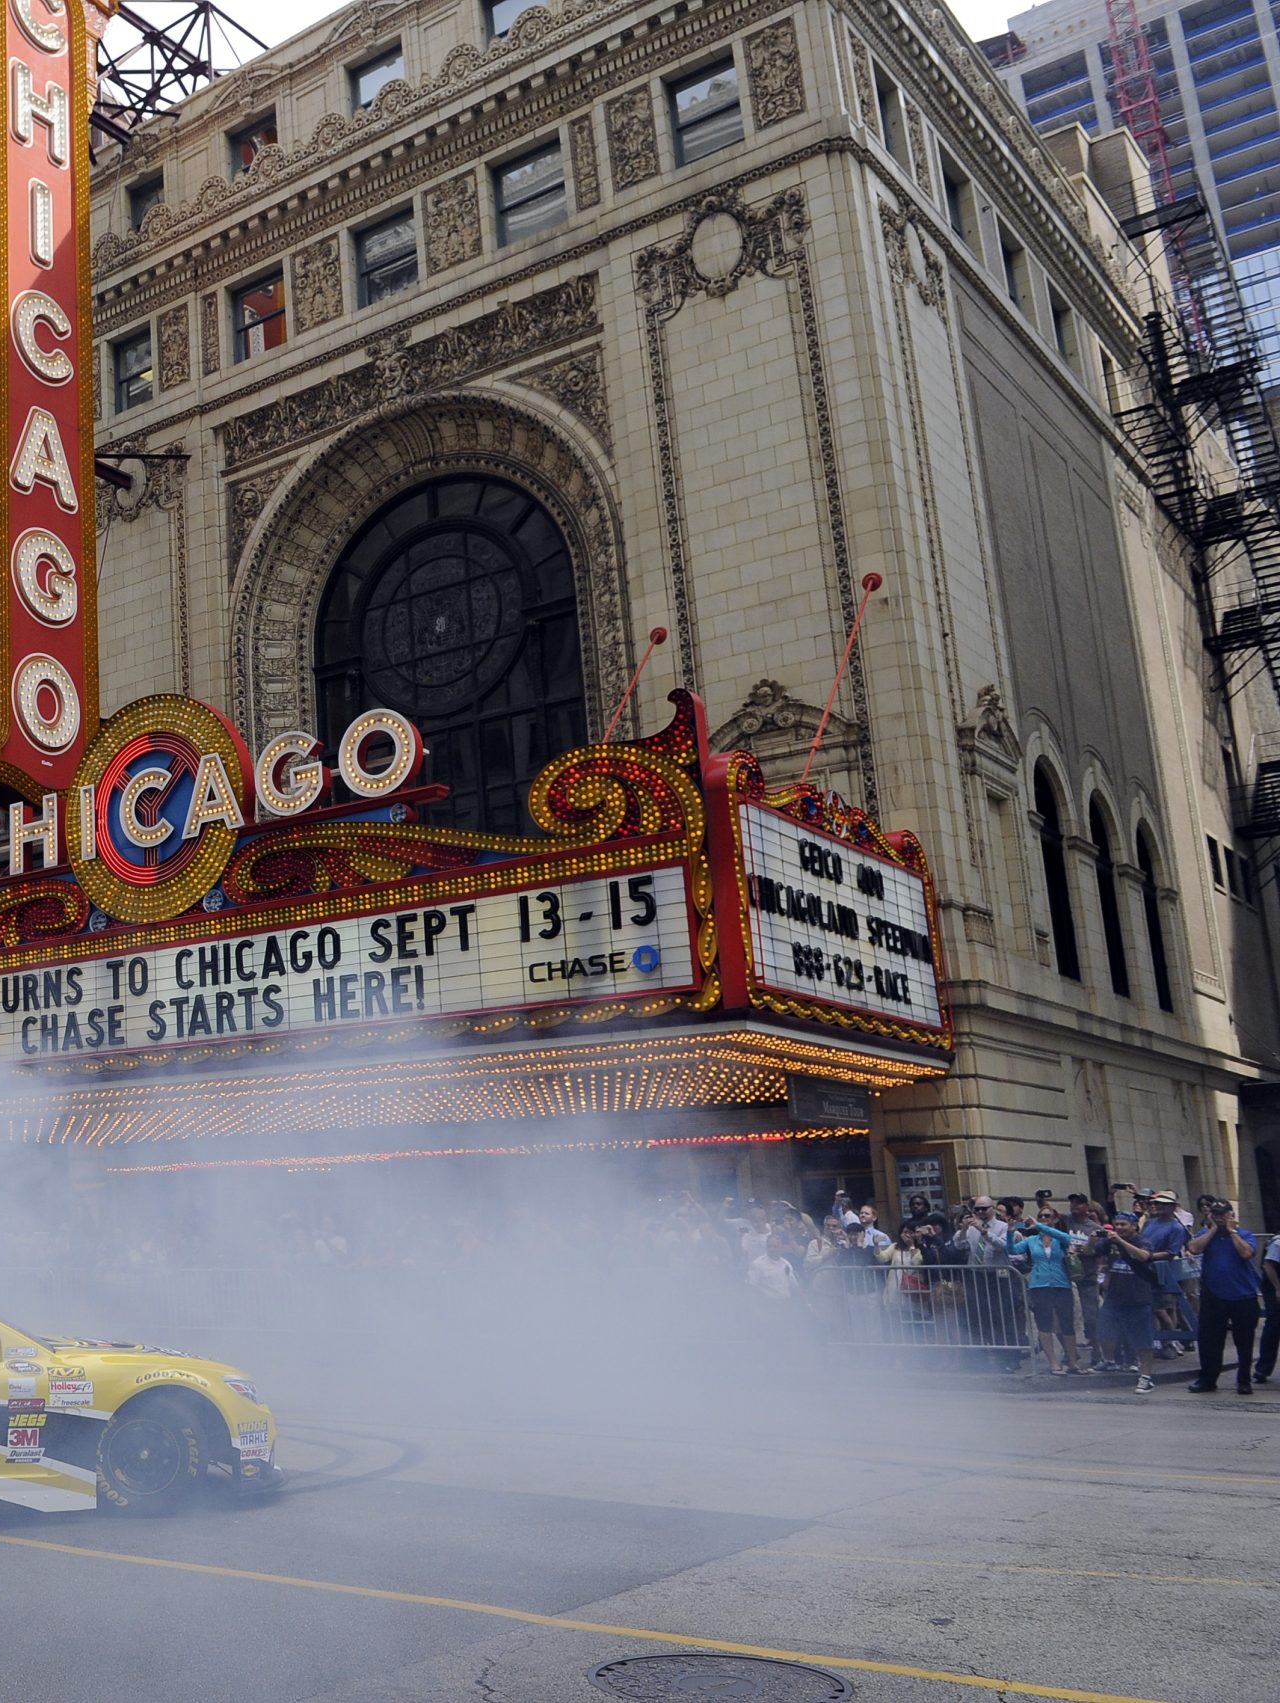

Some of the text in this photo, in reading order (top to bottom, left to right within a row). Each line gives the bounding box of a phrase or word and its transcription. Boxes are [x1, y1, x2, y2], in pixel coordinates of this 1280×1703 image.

[7, 0, 82, 756] CHICAGO
[799, 837, 844, 885] GEICO
[747, 872, 860, 940] CHICAGOLAND
[106, 954, 150, 1001] TO
[175, 926, 342, 993] CHICAGO
[370, 903, 476, 964] SEPT
[528, 951, 630, 984] CHASE
[21, 1004, 125, 1056] CHASE
[147, 983, 284, 1042] STARTS
[313, 964, 426, 1022] HERE!
[51, 1382, 77, 1392] Holley
[61, 1399, 91, 1407] freescale
[9, 1414, 48, 1427] JEGS
[9, 1429, 38, 1446] 3M
[240, 1432, 268, 1446] MAHLE
[9, 1448, 43, 1458] Duralast
